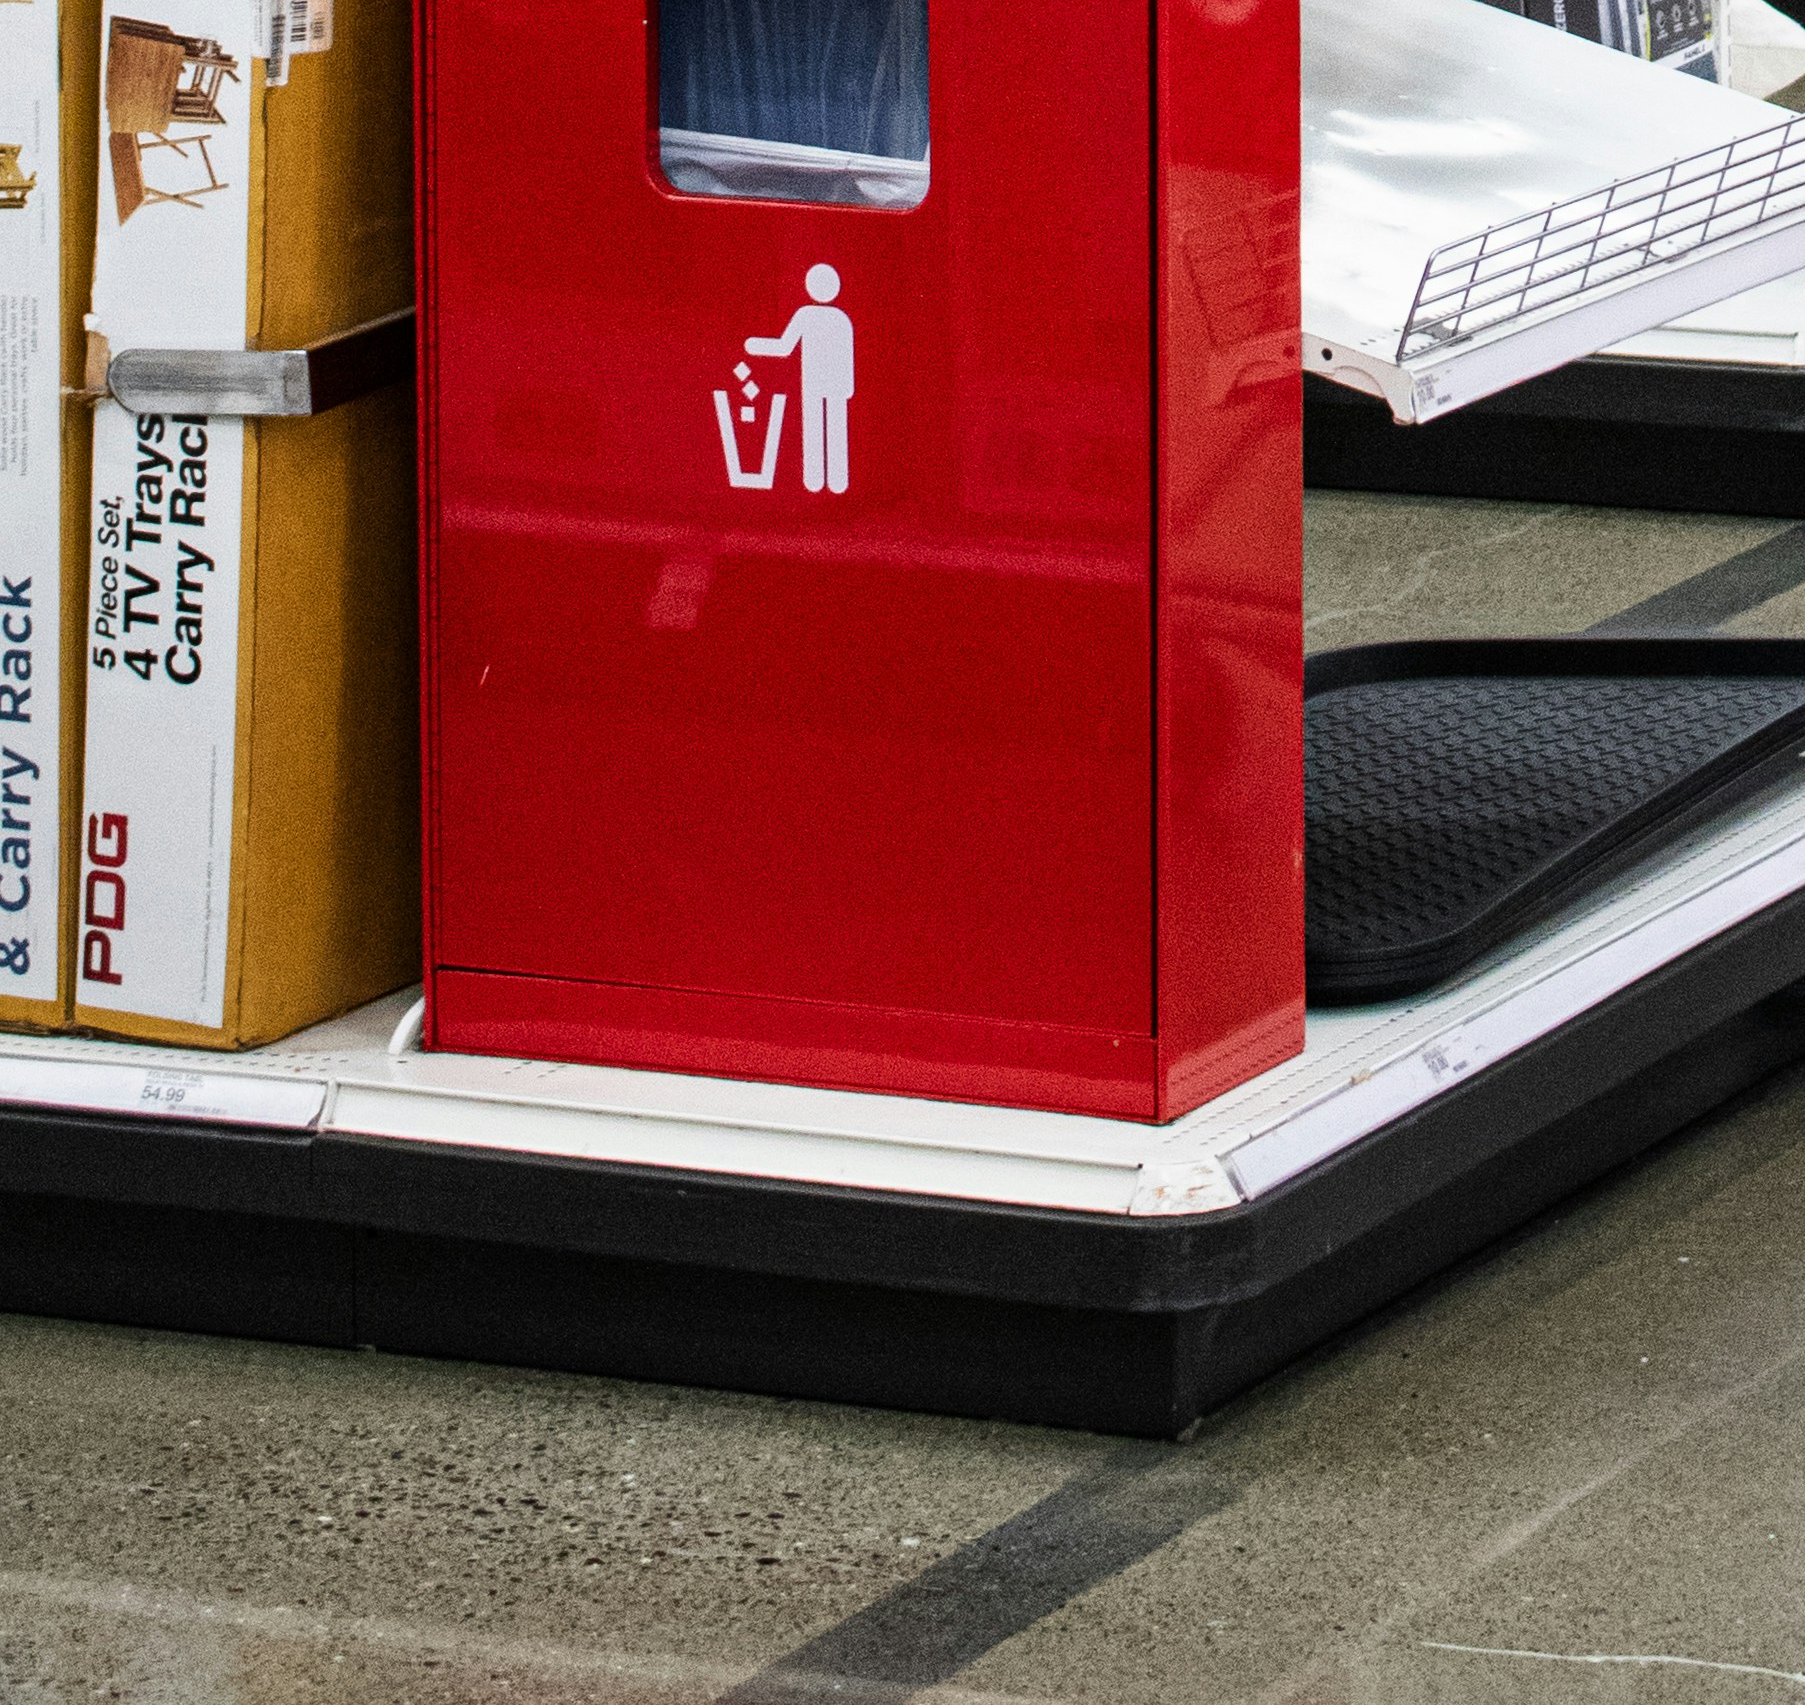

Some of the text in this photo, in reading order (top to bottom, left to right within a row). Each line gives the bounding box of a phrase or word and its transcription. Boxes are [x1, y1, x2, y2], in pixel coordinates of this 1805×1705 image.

[93, 495, 125, 671] 5 Piece Set,
[122, 413, 174, 681] 4 TV Trays
[165, 540, 216, 685] Carry
[0, 575, 40, 976] & Carry Rack
[82, 812, 129, 986] PDG
[141, 1085, 186, 1102] 54.99
